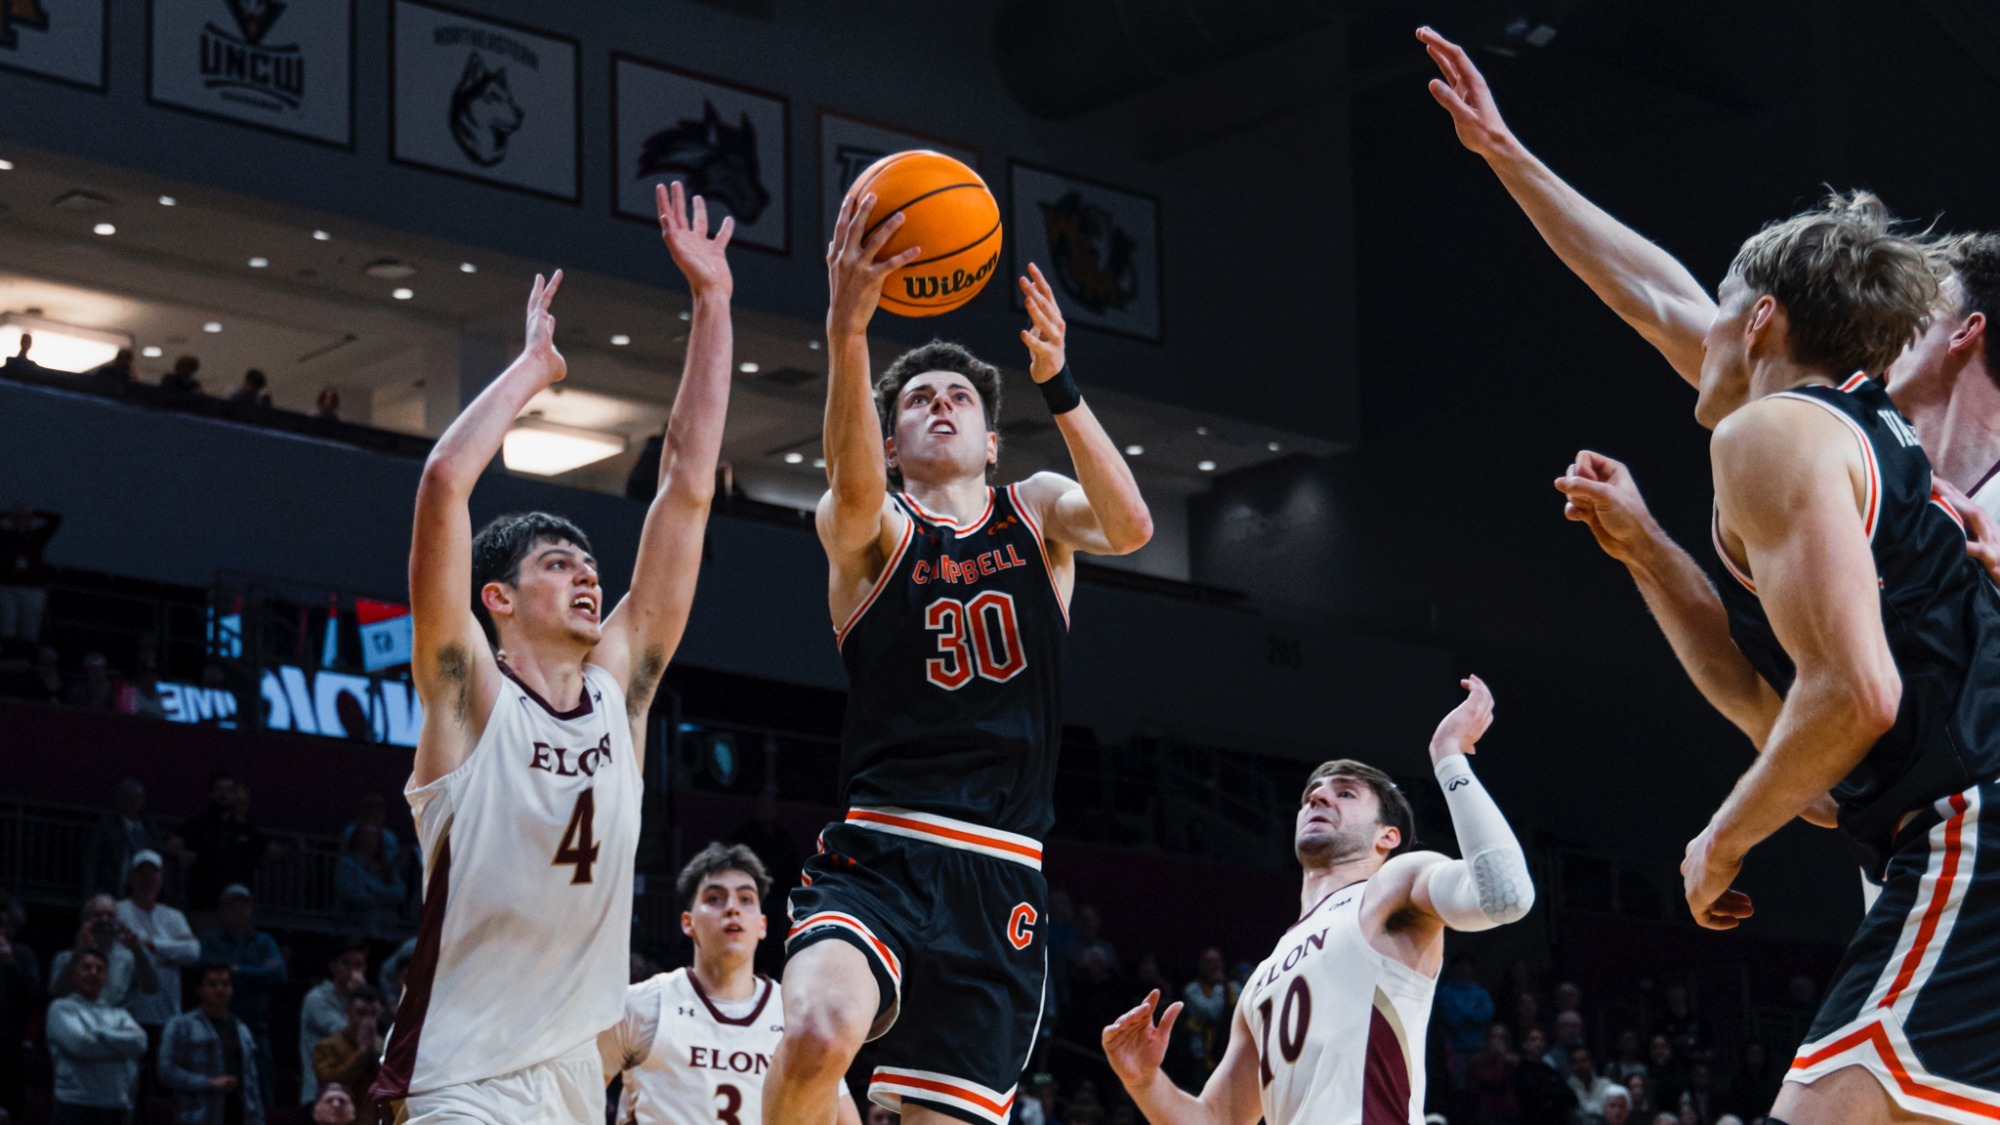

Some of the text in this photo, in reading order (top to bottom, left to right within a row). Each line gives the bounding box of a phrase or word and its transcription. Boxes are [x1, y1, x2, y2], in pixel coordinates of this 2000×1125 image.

[201, 34, 305, 97] UNCW
[903, 252, 997, 299] Wilson
[924, 589, 1028, 692] 30
[551, 786, 602, 886] 4
[1007, 902, 1038, 951] C
[1257, 973, 1312, 1091] 10
[714, 1082, 743, 1125] 3
